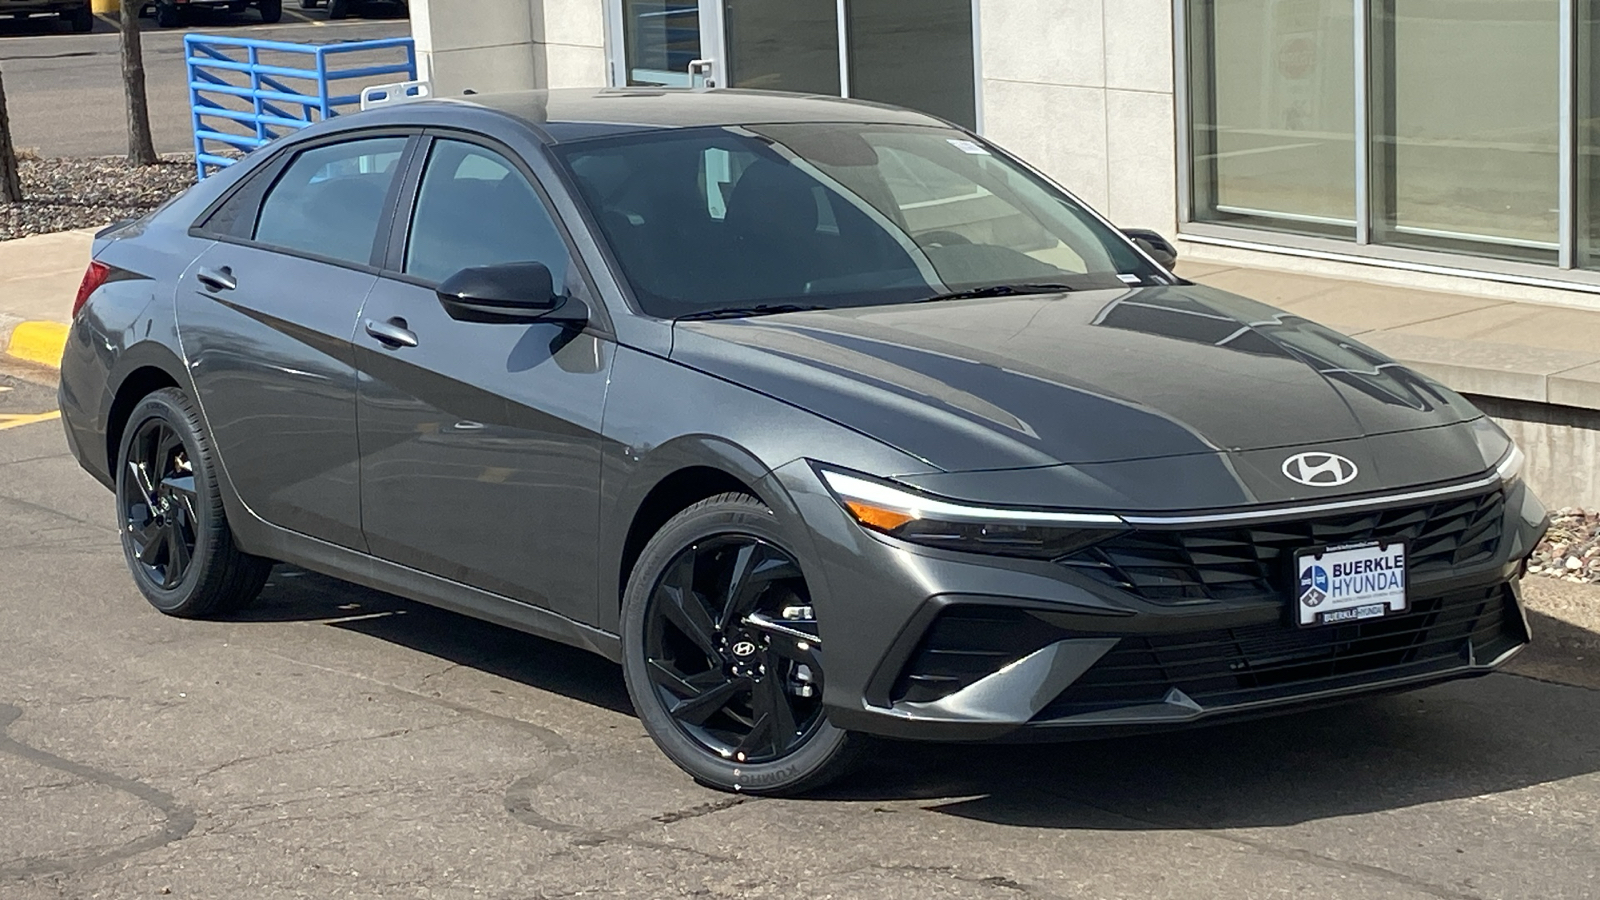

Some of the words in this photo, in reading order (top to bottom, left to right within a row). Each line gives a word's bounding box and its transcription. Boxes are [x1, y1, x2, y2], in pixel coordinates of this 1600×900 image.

[1333, 555, 1403, 578] BUERKLE
[1333, 570, 1404, 597] HYUNDAI
[1325, 609, 1358, 622] BUERKLE
[740, 765, 798, 784] KUMHO
